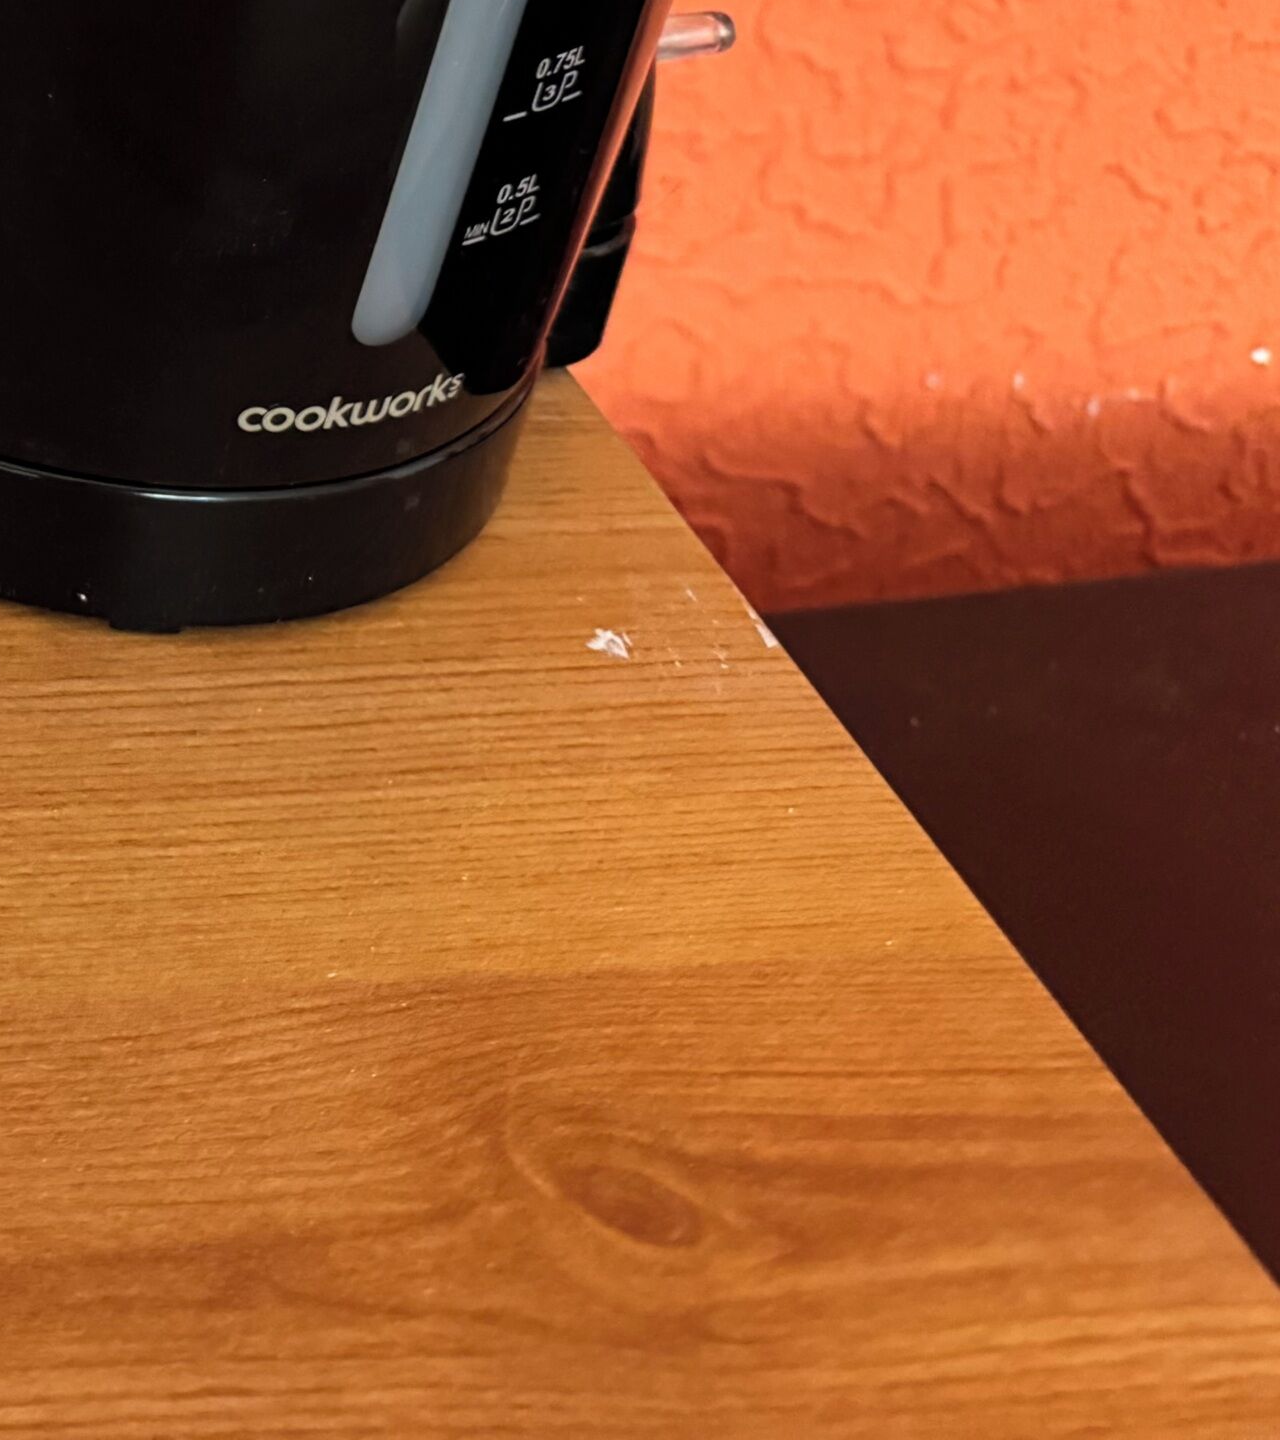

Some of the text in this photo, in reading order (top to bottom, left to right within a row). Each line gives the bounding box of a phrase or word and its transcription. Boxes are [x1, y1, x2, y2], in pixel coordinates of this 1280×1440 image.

[536, 45, 586, 80] 0.75L
[542, 84, 557, 102] 3
[496, 173, 540, 205] 0.5L
[500, 208, 516, 225] 2
[463, 220, 491, 240] MIN
[237, 372, 466, 433] cookworks
